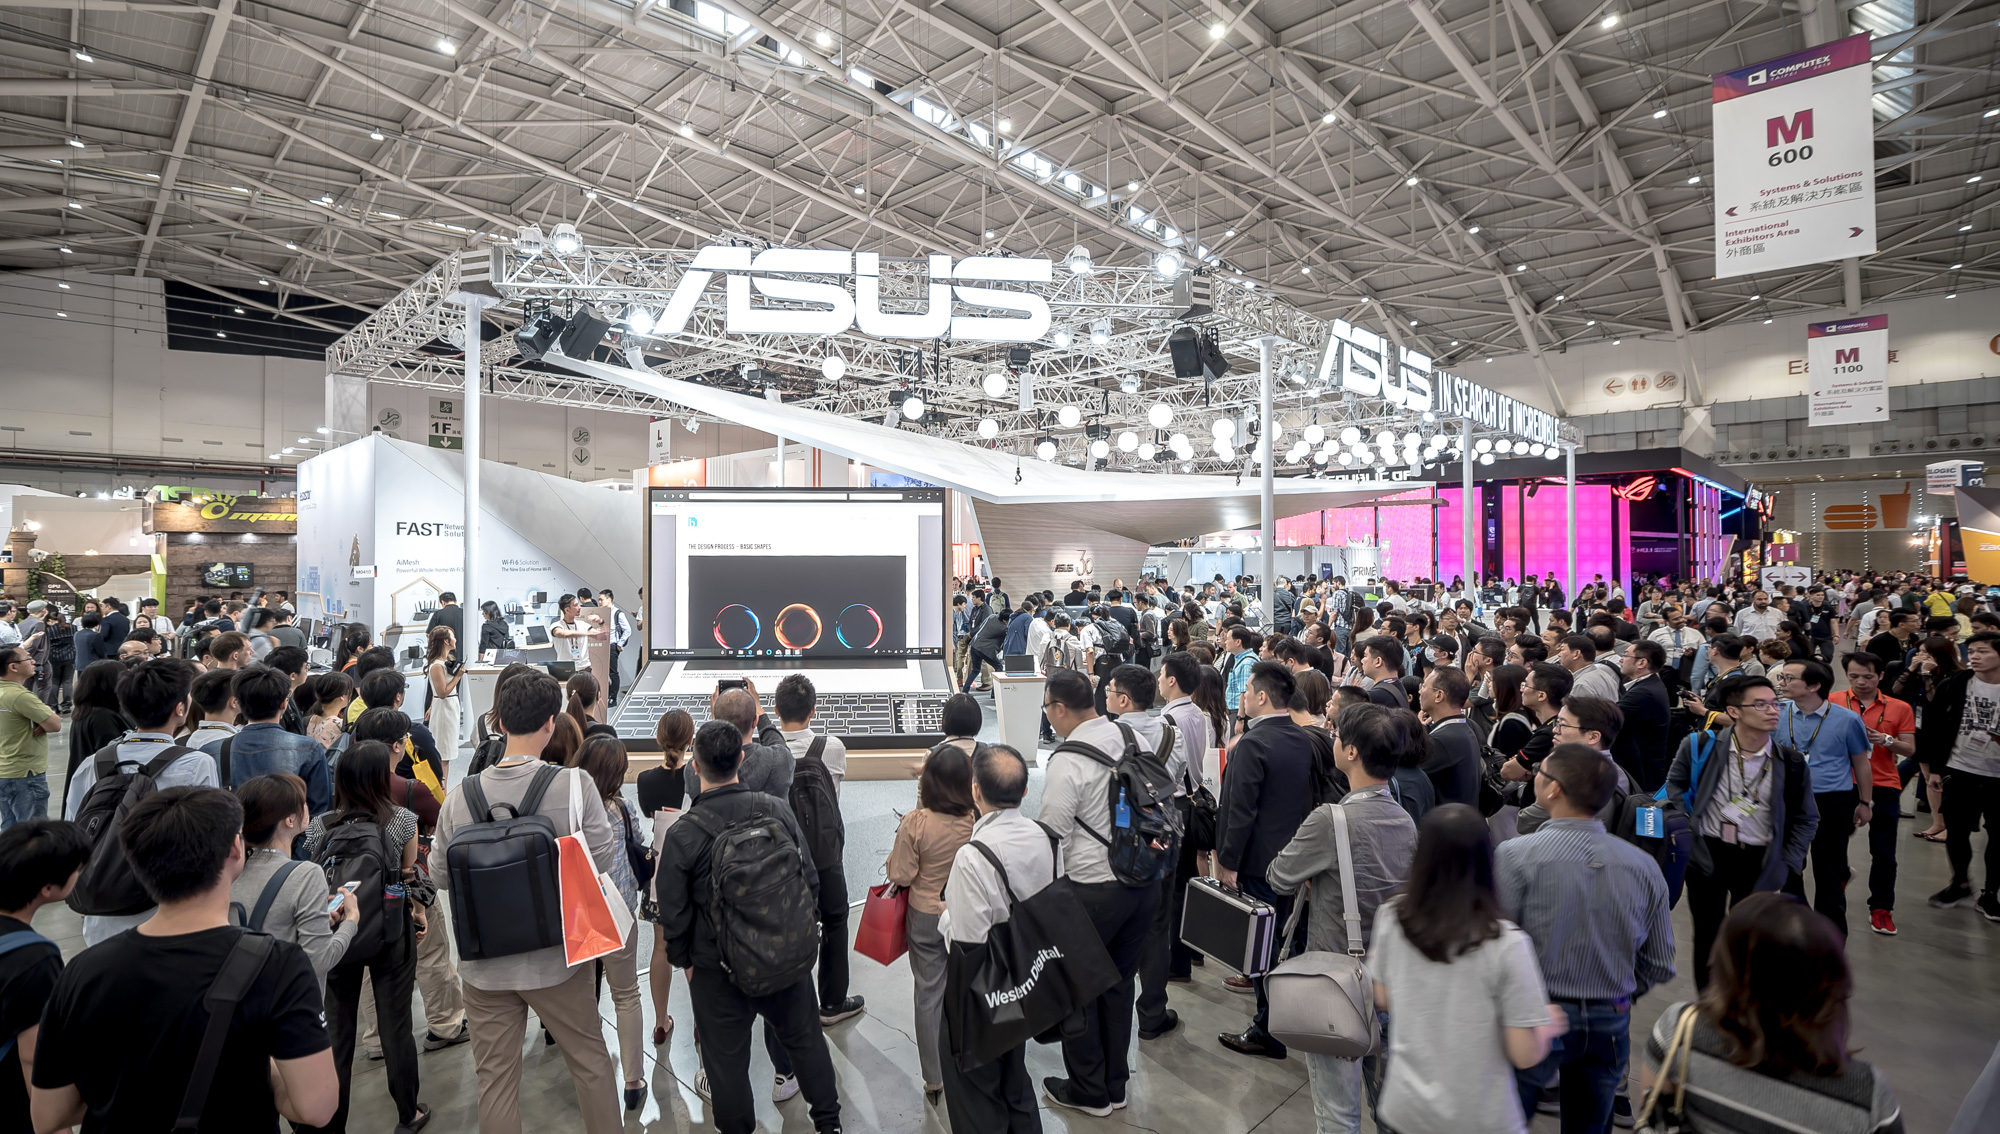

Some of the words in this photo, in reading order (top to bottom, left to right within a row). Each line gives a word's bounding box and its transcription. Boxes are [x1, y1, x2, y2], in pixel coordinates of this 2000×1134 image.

[1770, 54, 1831, 77] COMPUTEX
[1770, 71, 1798, 82] TAIPEI
[1766, 108, 1814, 148] M
[1768, 144, 1814, 167] 600
[1760, 182, 1801, 197] Systems
[1802, 180, 1812, 188] &
[1812, 170, 1864, 186] Solutions
[1749, 181, 1863, 213] 系統及解決方案區
[1725, 220, 1790, 238] International
[1725, 232, 1775, 247] Exhibitors
[1776, 227, 1800, 238] Area
[1725, 242, 1766, 258] 外商區
[653, 246, 1052, 341] ASUS
[1836, 348, 1860, 364] M
[1833, 364, 1864, 374] 1100
[1318, 318, 1432, 412] ASUS
[1438, 370, 1452, 413] IN
[1454, 376, 1497, 429] SEARCH
[1498, 394, 1512, 432] OF
[1512, 400, 1560, 448] INCREDIBLE
[432, 422, 452, 434] 1F
[396, 522, 444, 536] FAST
[1054, 564, 1074, 572] ASUS
[985, 978, 1035, 1008] Western
[1031, 946, 1064, 982] Digital.
